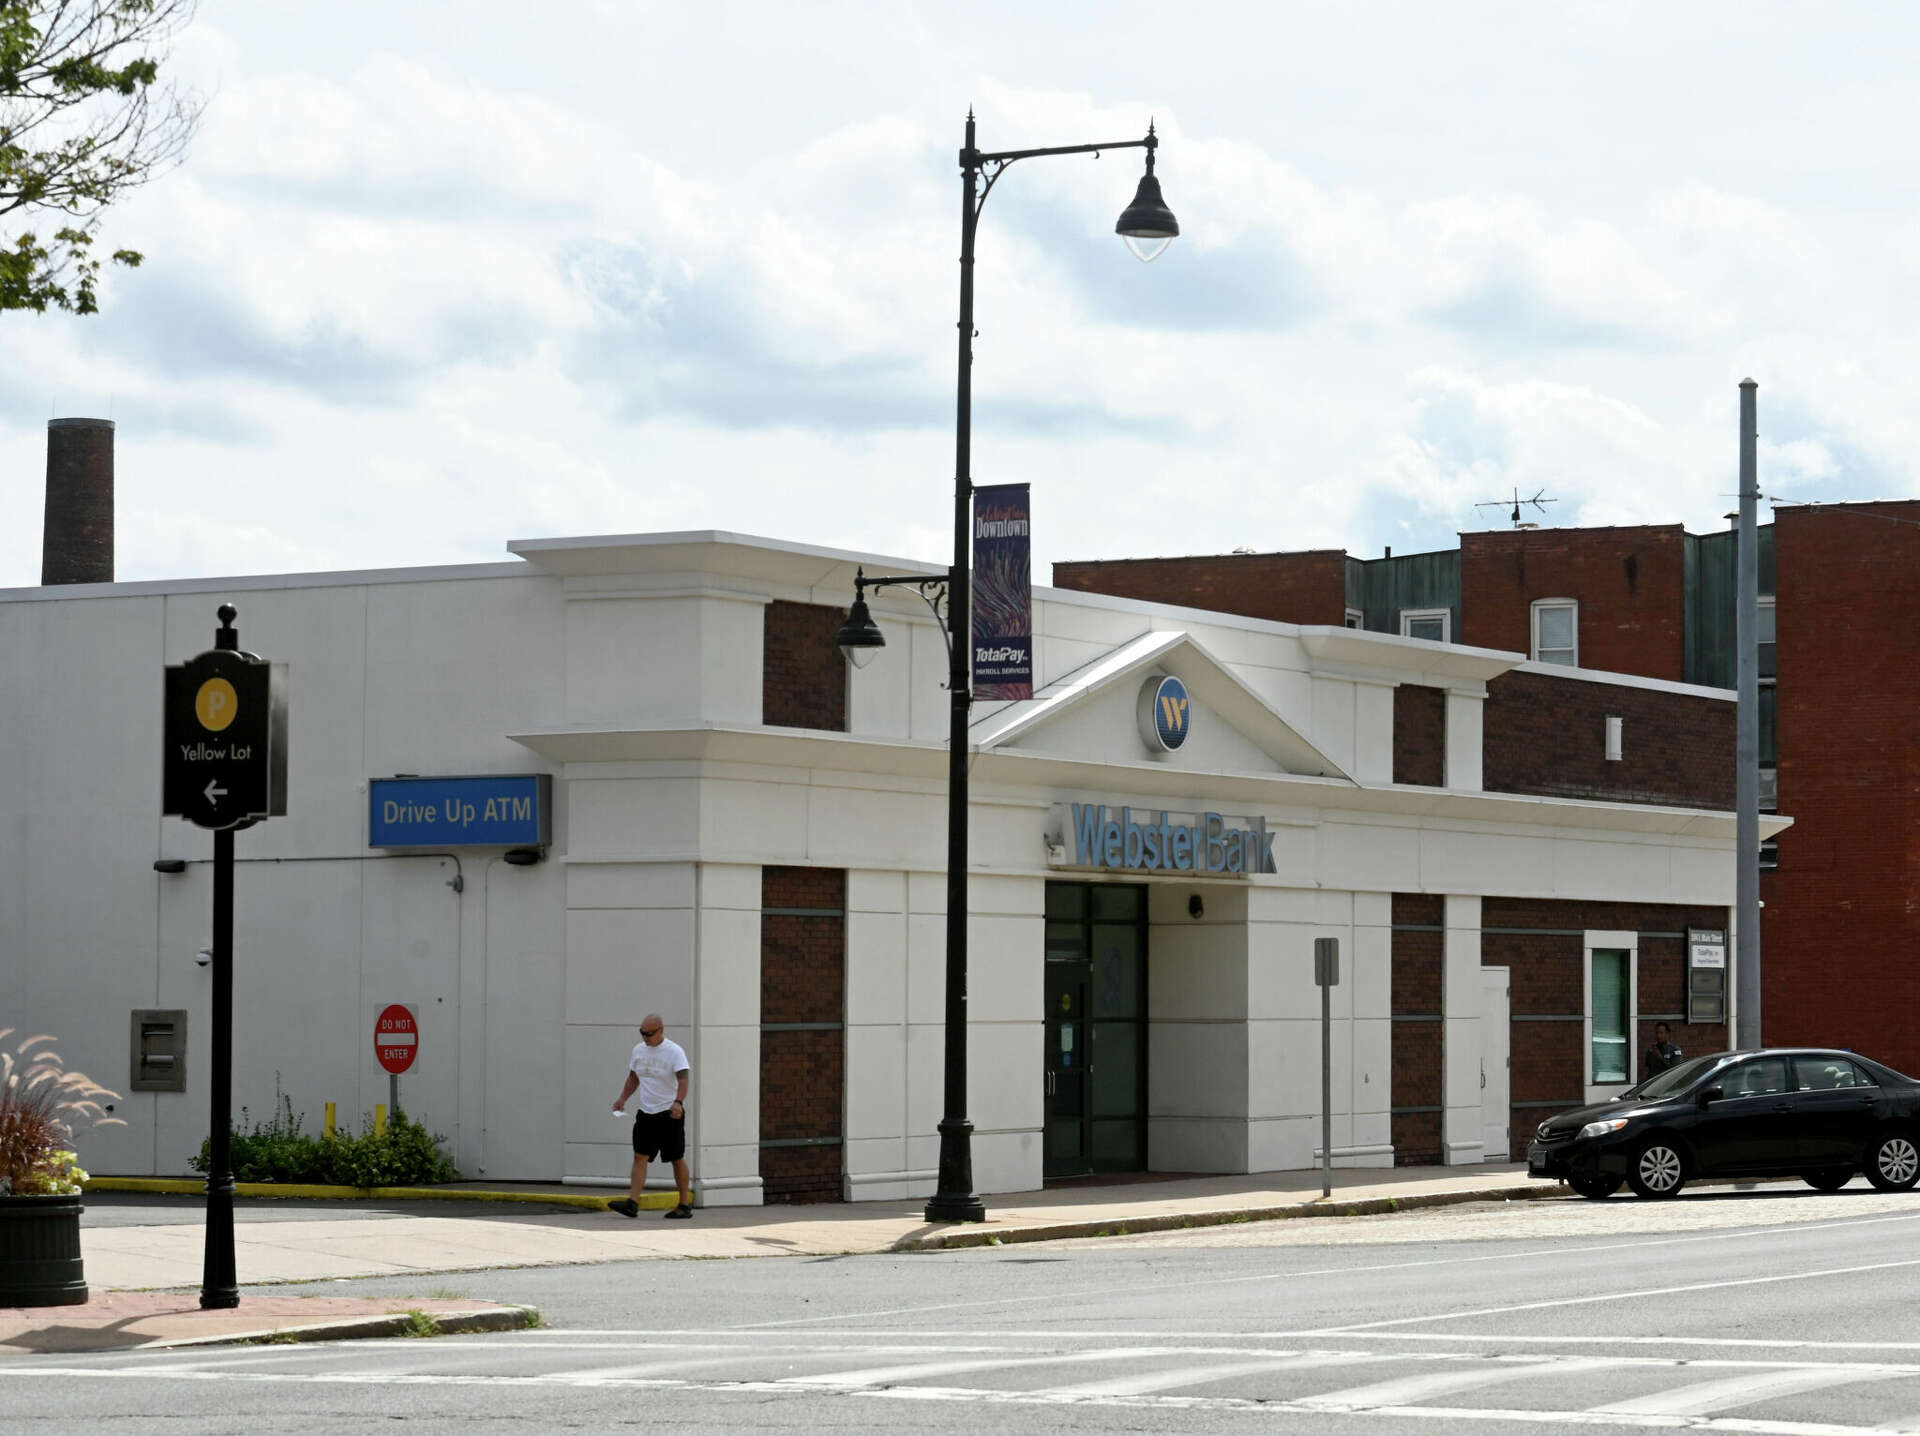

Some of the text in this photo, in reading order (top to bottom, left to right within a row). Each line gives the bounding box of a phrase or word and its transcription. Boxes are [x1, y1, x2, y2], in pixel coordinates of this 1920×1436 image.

[976, 517, 1028, 538] Downtown
[209, 691, 227, 719] P
[180, 742, 251, 761] Yellow Lot
[383, 797, 531, 827] Drive Up ATM
[382, 1019, 411, 1030] DO NOT
[384, 1049, 408, 1060] ENTER
